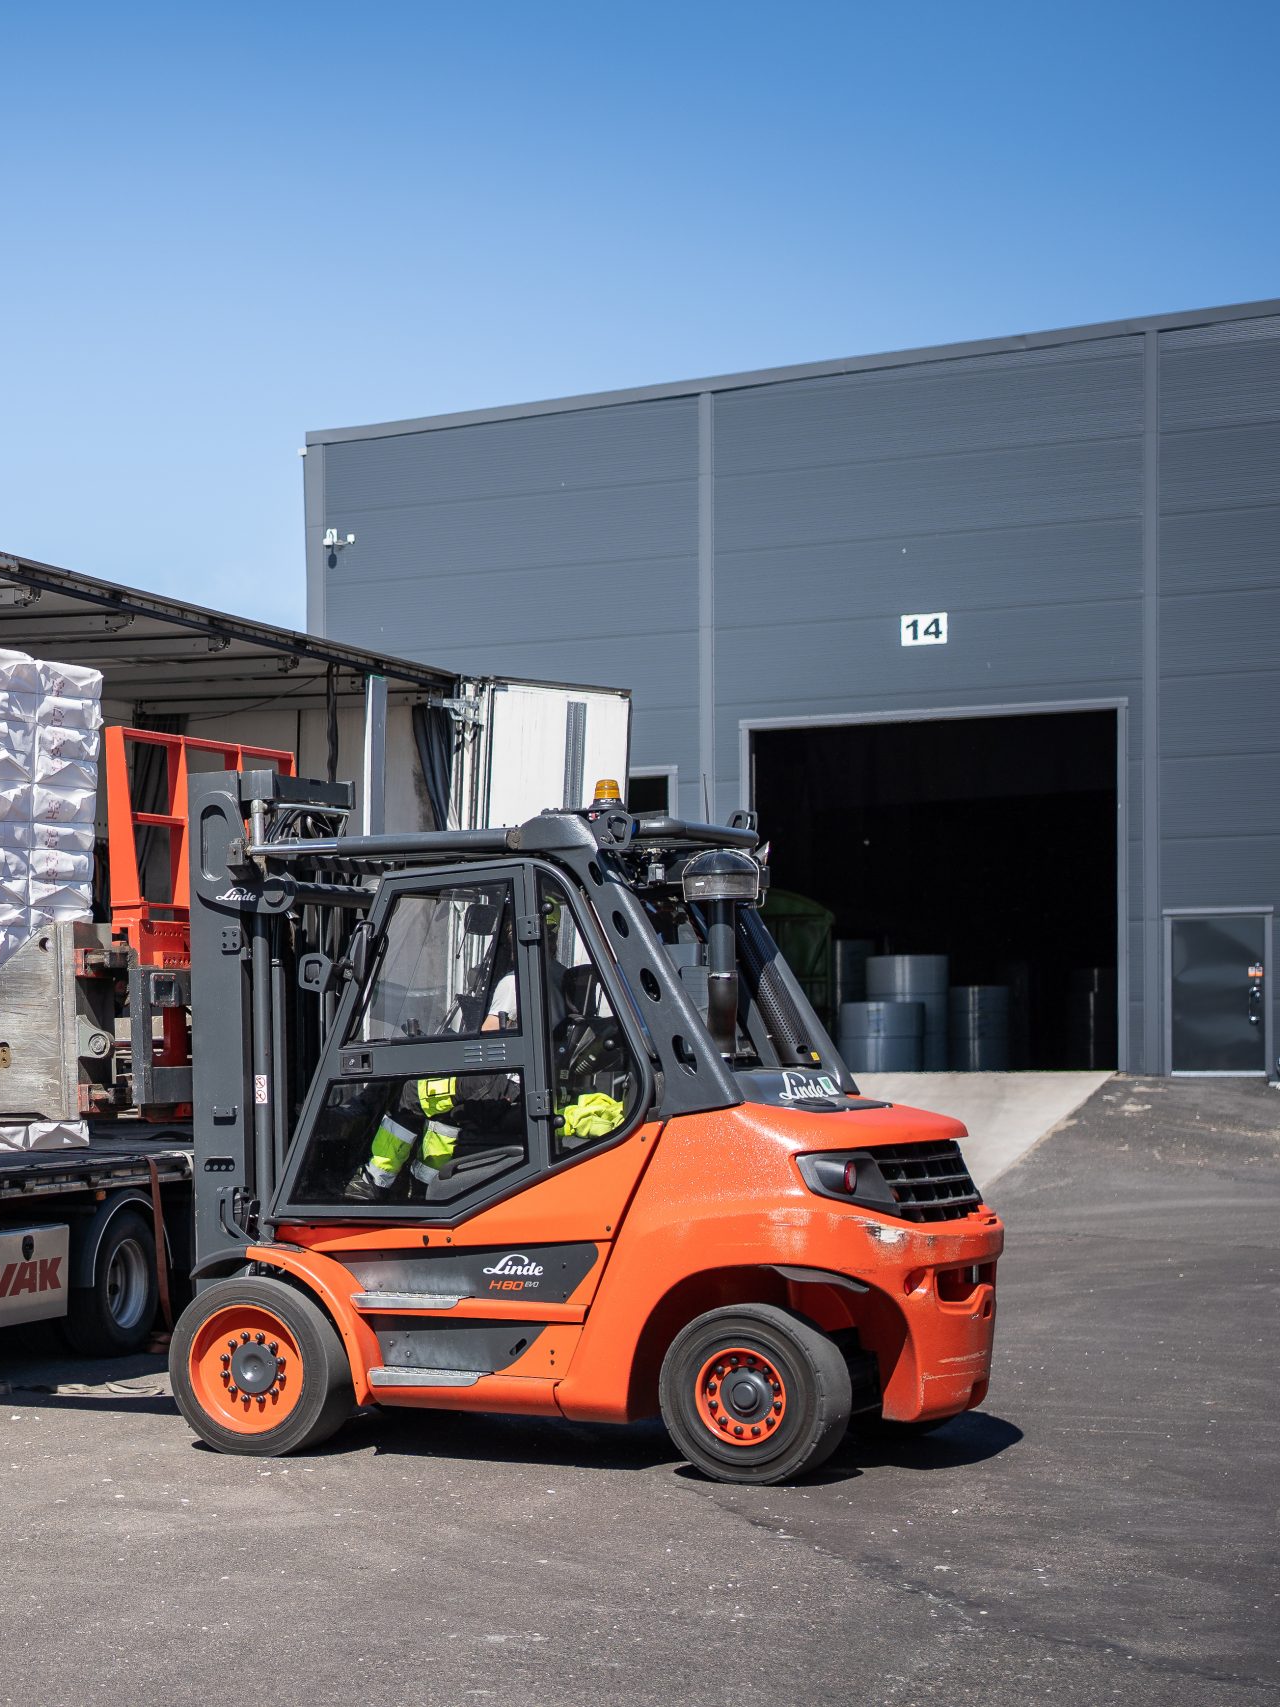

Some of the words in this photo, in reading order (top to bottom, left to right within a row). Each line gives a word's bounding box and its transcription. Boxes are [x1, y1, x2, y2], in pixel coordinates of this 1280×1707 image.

[906, 618, 942, 641] 14
[215, 887, 257, 902] Linde
[779, 1072, 826, 1100] Linde
[483, 1254, 544, 1276] Linde
